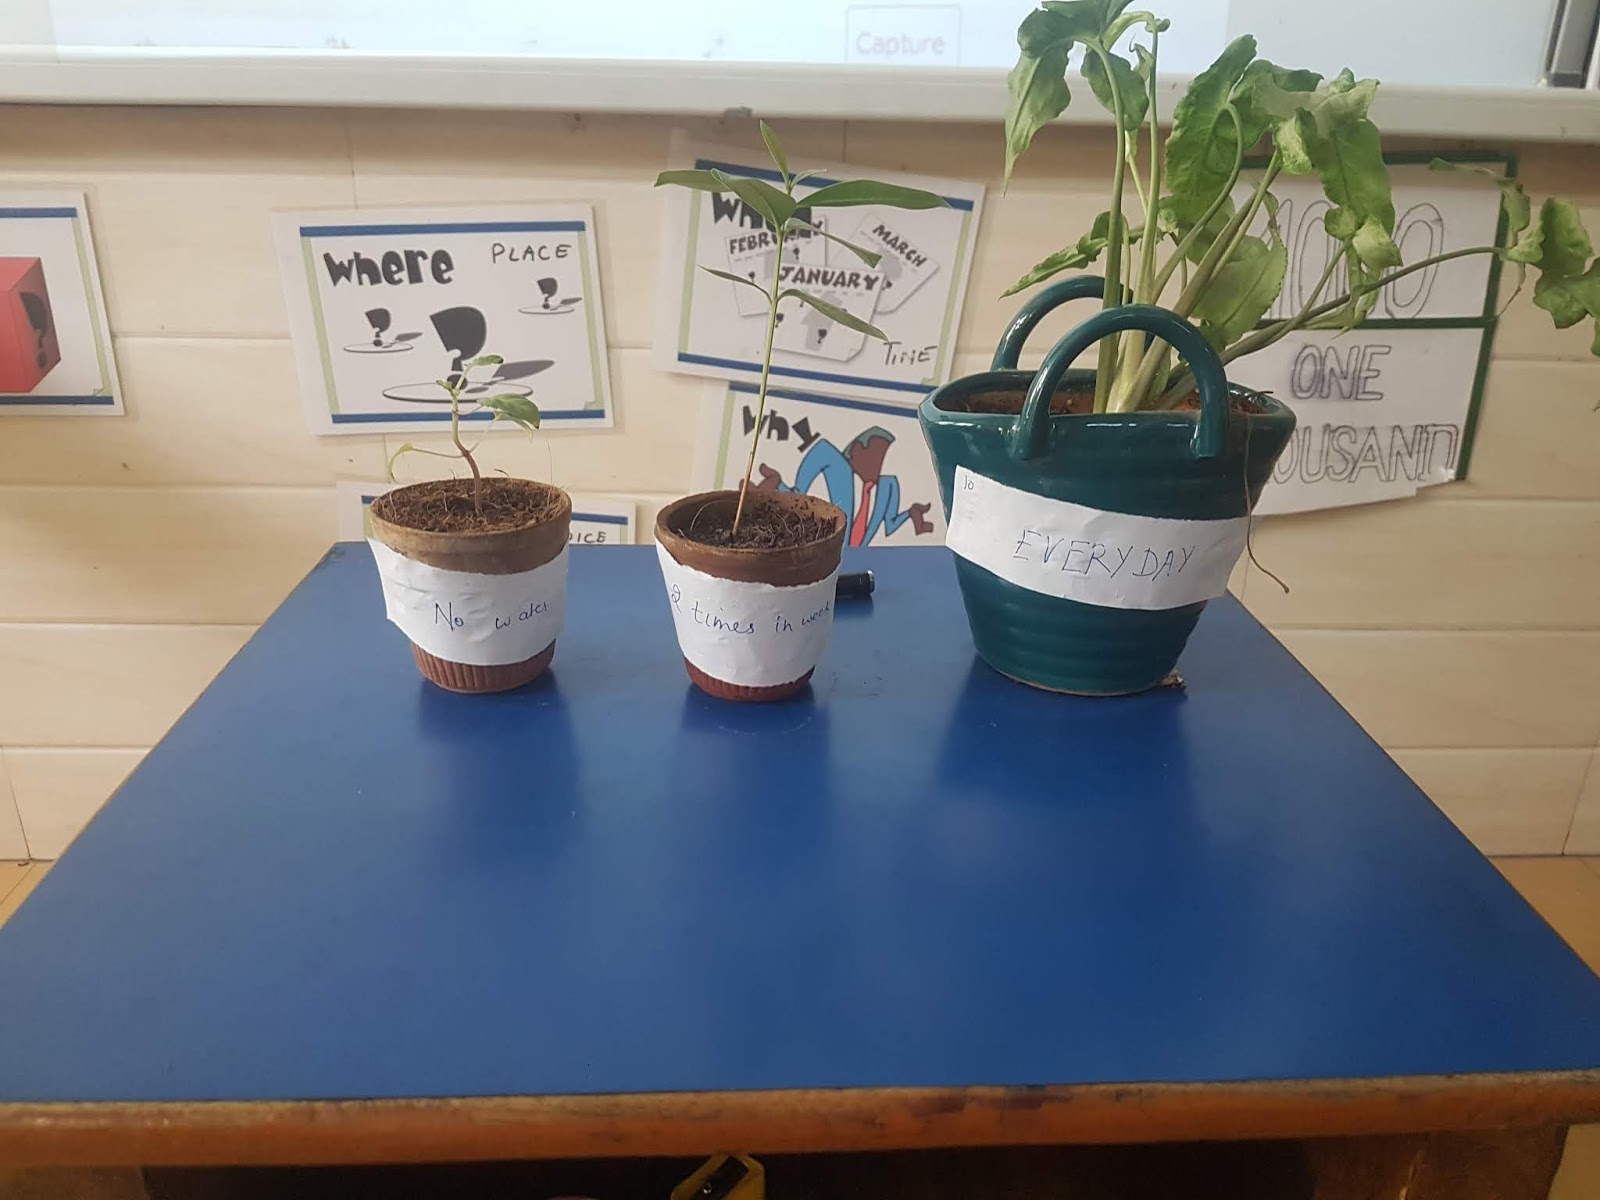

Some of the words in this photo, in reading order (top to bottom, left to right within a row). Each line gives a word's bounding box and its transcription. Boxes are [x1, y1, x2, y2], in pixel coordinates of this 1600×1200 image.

[856, 31, 945, 55] Capture
[492, 243, 572, 264] PLACE
[729, 220, 824, 255] FEBRY
[872, 224, 928, 267] MARCH
[1260, 199, 1444, 319] 100
[779, 266, 879, 291] JANUARY
[1291, 344, 1391, 400] ONE
[569, 531, 607, 543] ICE
[435, 602, 465, 632] No
[691, 600, 755, 634] times
[775, 615, 793, 633] in
